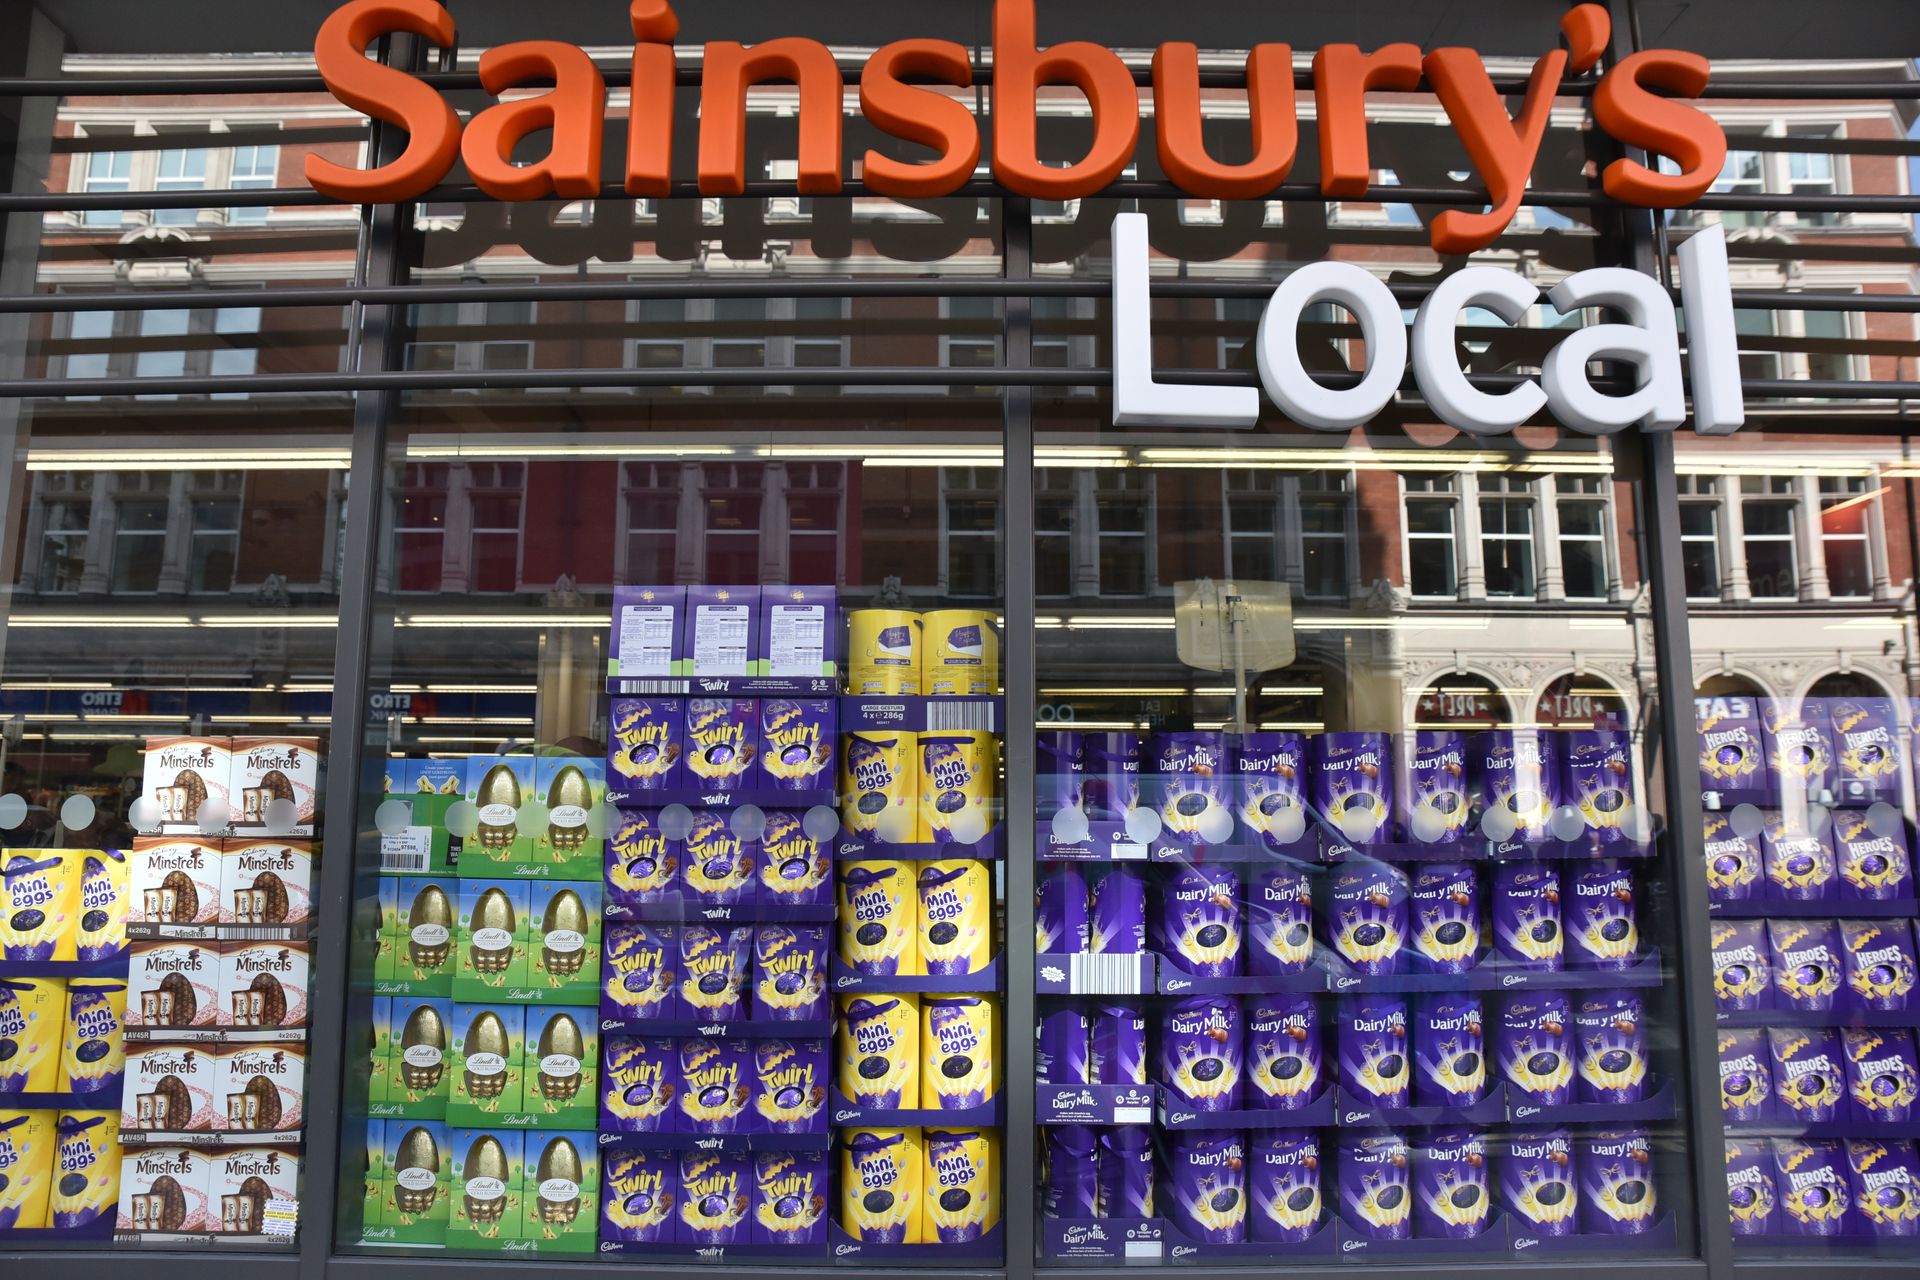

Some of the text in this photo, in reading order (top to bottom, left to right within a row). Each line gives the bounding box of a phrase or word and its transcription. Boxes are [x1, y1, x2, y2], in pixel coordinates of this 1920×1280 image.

[304, 0, 1729, 256] Sainsbury's
[1110, 211, 1746, 436] Local
[701, 681, 729, 691] Twirl
[883, 712, 904, 721] 286g
[615, 721, 668, 746] Twirl
[689, 721, 744, 746] Twirl
[765, 722, 820, 747] Twirl
[1704, 726, 1748, 750] HEROES
[1844, 726, 1889, 750] HEROES
[160, 750, 214, 769] Minstrels
[246, 749, 301, 770] Minstrels
[855, 759, 888, 780] Mini
[933, 758, 966, 779] Mini
[1159, 752, 1214, 773] Dairy Milk
[1239, 753, 1296, 772] Dairy Milk
[1354, 752, 1378, 769] Milk
[1442, 752, 1462, 768] Milk
[1486, 750, 1544, 771] Dairy Milk
[857, 772, 893, 791] eggs
[935, 771, 972, 789] eggs
[702, 793, 730, 805] Twirl
[611, 833, 665, 859] Twirl
[687, 834, 742, 860] Twirl
[763, 835, 818, 860] Twirl
[1704, 837, 1747, 860] HEROES
[1847, 837, 1894, 860] HEROES
[148, 851, 204, 870] Minstrels
[238, 851, 294, 870] Minstrels
[513, 865, 542, 875] Lindt
[12, 876, 49, 894] Mini
[83, 877, 112, 896] Mini
[1208, 881, 1232, 898] Milk
[1264, 882, 1312, 903] Dairy Milk
[1577, 877, 1632, 898] Dairy Milk
[12, 889, 54, 907] eggs
[83, 889, 117, 908] eggs
[854, 889, 887, 910] Mini
[926, 889, 958, 909] Mini
[702, 908, 731, 919] Twirl
[855, 901, 892, 922] eggs
[928, 901, 964, 921] eggs
[145, 953, 202, 972] Minstrels
[236, 953, 292, 972] Minstrels
[609, 948, 663, 972] Twirl
[683, 950, 736, 974] Twirl
[759, 950, 814, 974] Twirl
[1712, 945, 1757, 969] HEROES
[1783, 945, 1830, 969] HEROES
[1855, 945, 1902, 970] HEROES
[376, 983, 401, 993] Lindt
[506, 989, 535, 1000] Lindt
[78, 1006, 112, 1026] Mini
[1172, 1014, 1229, 1035] Dairy Milk
[1282, 1014, 1309, 1028] Milk
[1354, 1010, 1406, 1032] Dairy Milk
[1463, 1010, 1482, 1025] Milk
[77, 1020, 118, 1039] eggs
[127, 1031, 150, 1040] AV45R
[278, 1031, 302, 1041] 4x262g
[698, 1025, 726, 1036] Twirl
[856, 1022, 891, 1041] Mini
[939, 1021, 973, 1041] Mini
[858, 1034, 895, 1054] eggs
[941, 1034, 978, 1054] eggs
[140, 1055, 197, 1074] Minstrels
[230, 1055, 287, 1074] Minstrels
[608, 1060, 662, 1084] Twirl
[683, 1062, 737, 1086] Twirl
[1784, 1055, 1830, 1079] HEROES
[1857, 1055, 1905, 1080] HEROES
[758, 1063, 813, 1088] Twirl
[369, 1104, 395, 1114] Lindt
[1052, 1098, 1076, 1110] Dairy
[501, 1114, 530, 1125] Lindt
[60, 1137, 91, 1157] Mini
[123, 1134, 146, 1142] AV45R
[273, 1134, 297, 1143] 4x262g
[695, 1138, 723, 1149] Twirl
[1512, 1137, 1569, 1158] Dairy Milk
[1626, 1136, 1649, 1151] Milk
[60, 1151, 96, 1171] eggs
[1190, 1144, 1243, 1167] Dairy Milk
[1299, 1144, 1318, 1159] Milk
[1428, 1141, 1484, 1162] Dairy Milk
[136, 1156, 192, 1175] Minstrels
[225, 1157, 281, 1176] Minstrels
[860, 1154, 894, 1176] Mini
[937, 1153, 970, 1173] Mini
[608, 1169, 662, 1194] Twirl
[683, 1171, 737, 1195] Twirl
[758, 1172, 813, 1196] Twirl
[862, 1167, 898, 1188] eggs
[939, 1167, 976, 1186] eggs
[1789, 1166, 1836, 1192] HEROES
[1862, 1166, 1911, 1192] HEROES
[363, 1228, 388, 1238] Lindt
[1063, 1233, 1087, 1244] Dairy
[501, 1240, 530, 1250] Lindt
[696, 1247, 724, 1256] Twirl
